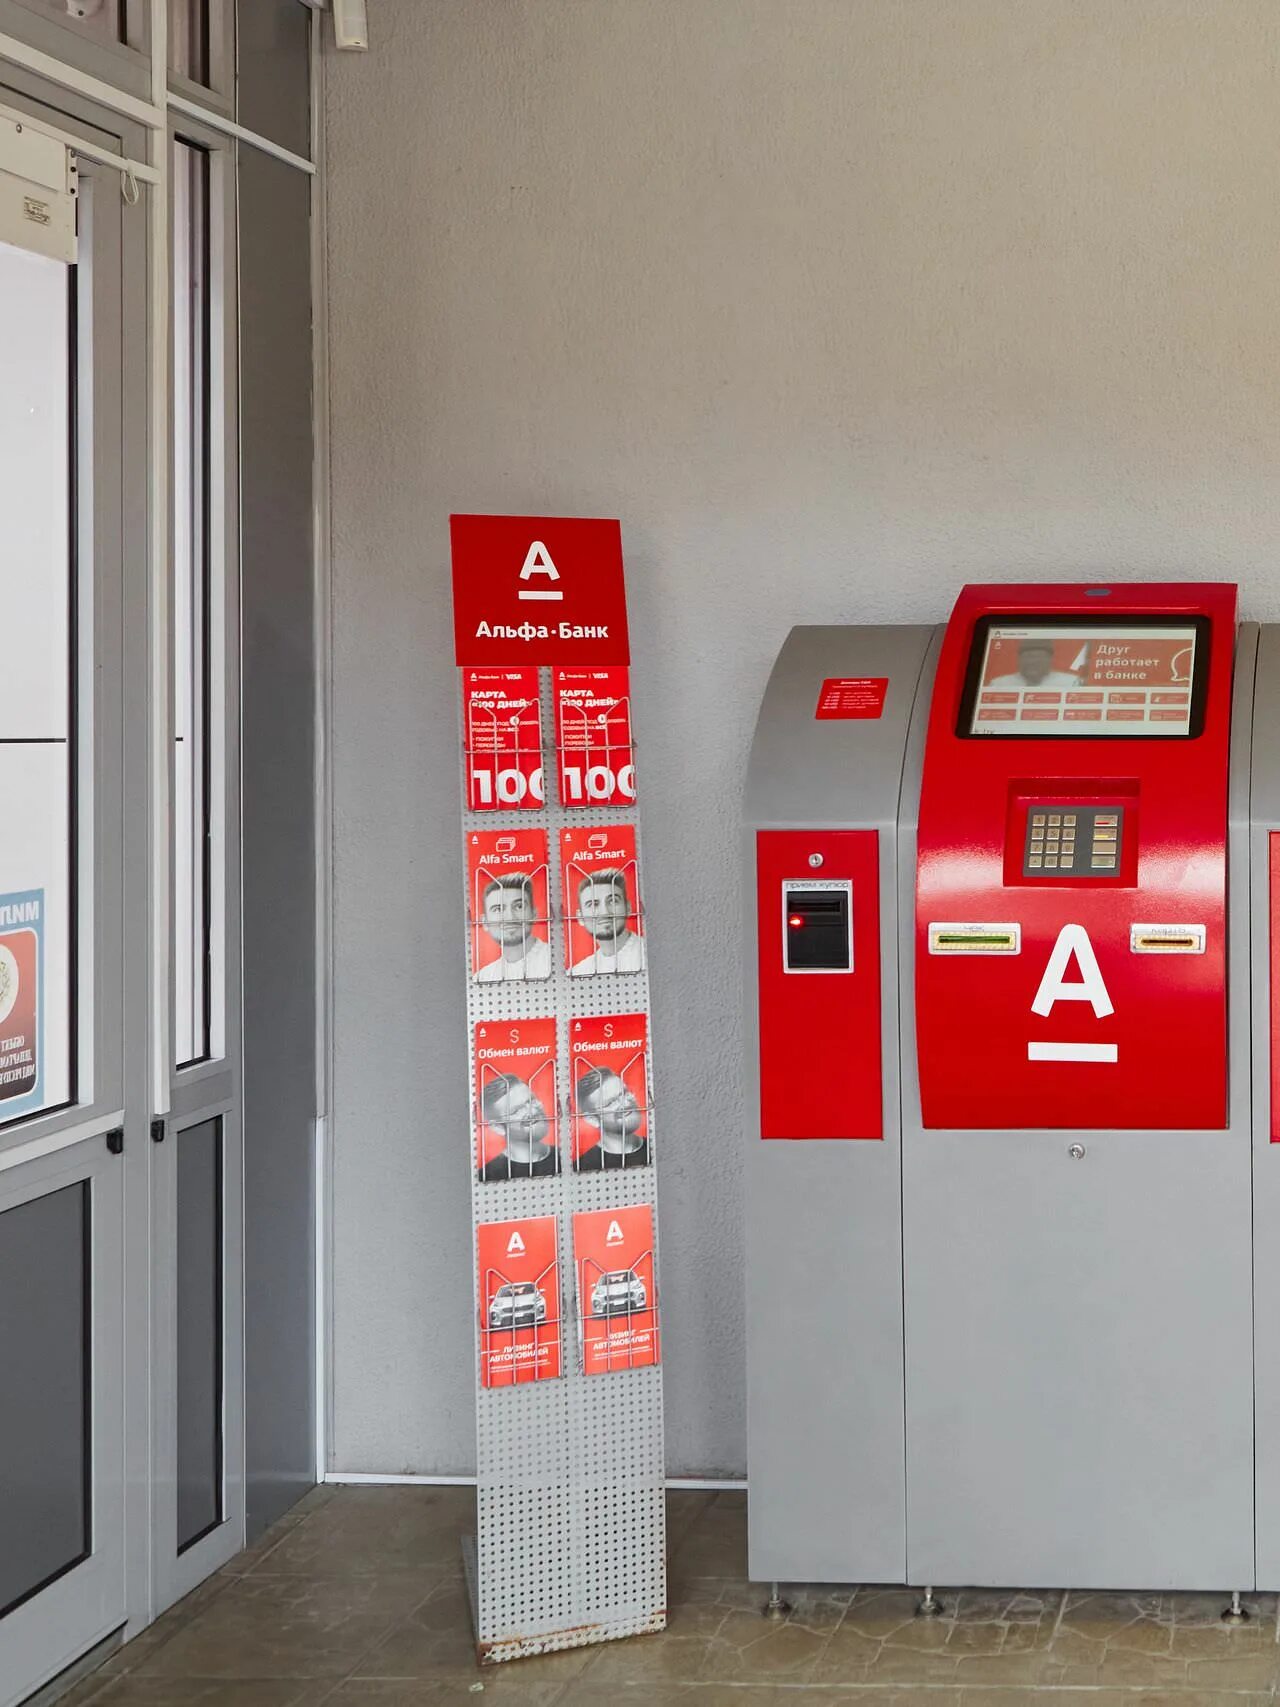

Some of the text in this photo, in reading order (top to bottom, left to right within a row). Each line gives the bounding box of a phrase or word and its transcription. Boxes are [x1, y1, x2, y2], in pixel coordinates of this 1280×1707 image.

[1096, 644, 1131, 656] Друг
[1095, 657, 1160, 668] работает
[1105, 670, 1147, 680] банке
[471, 691, 507, 699] КАРТА
[560, 689, 595, 697] КАРТА
[479, 853, 534, 865] Alfa Smart
[572, 849, 626, 861] Alfa Smart
[573, 1039, 643, 1052] Обмен валют
[478, 1045, 550, 1059] Обмен валют
